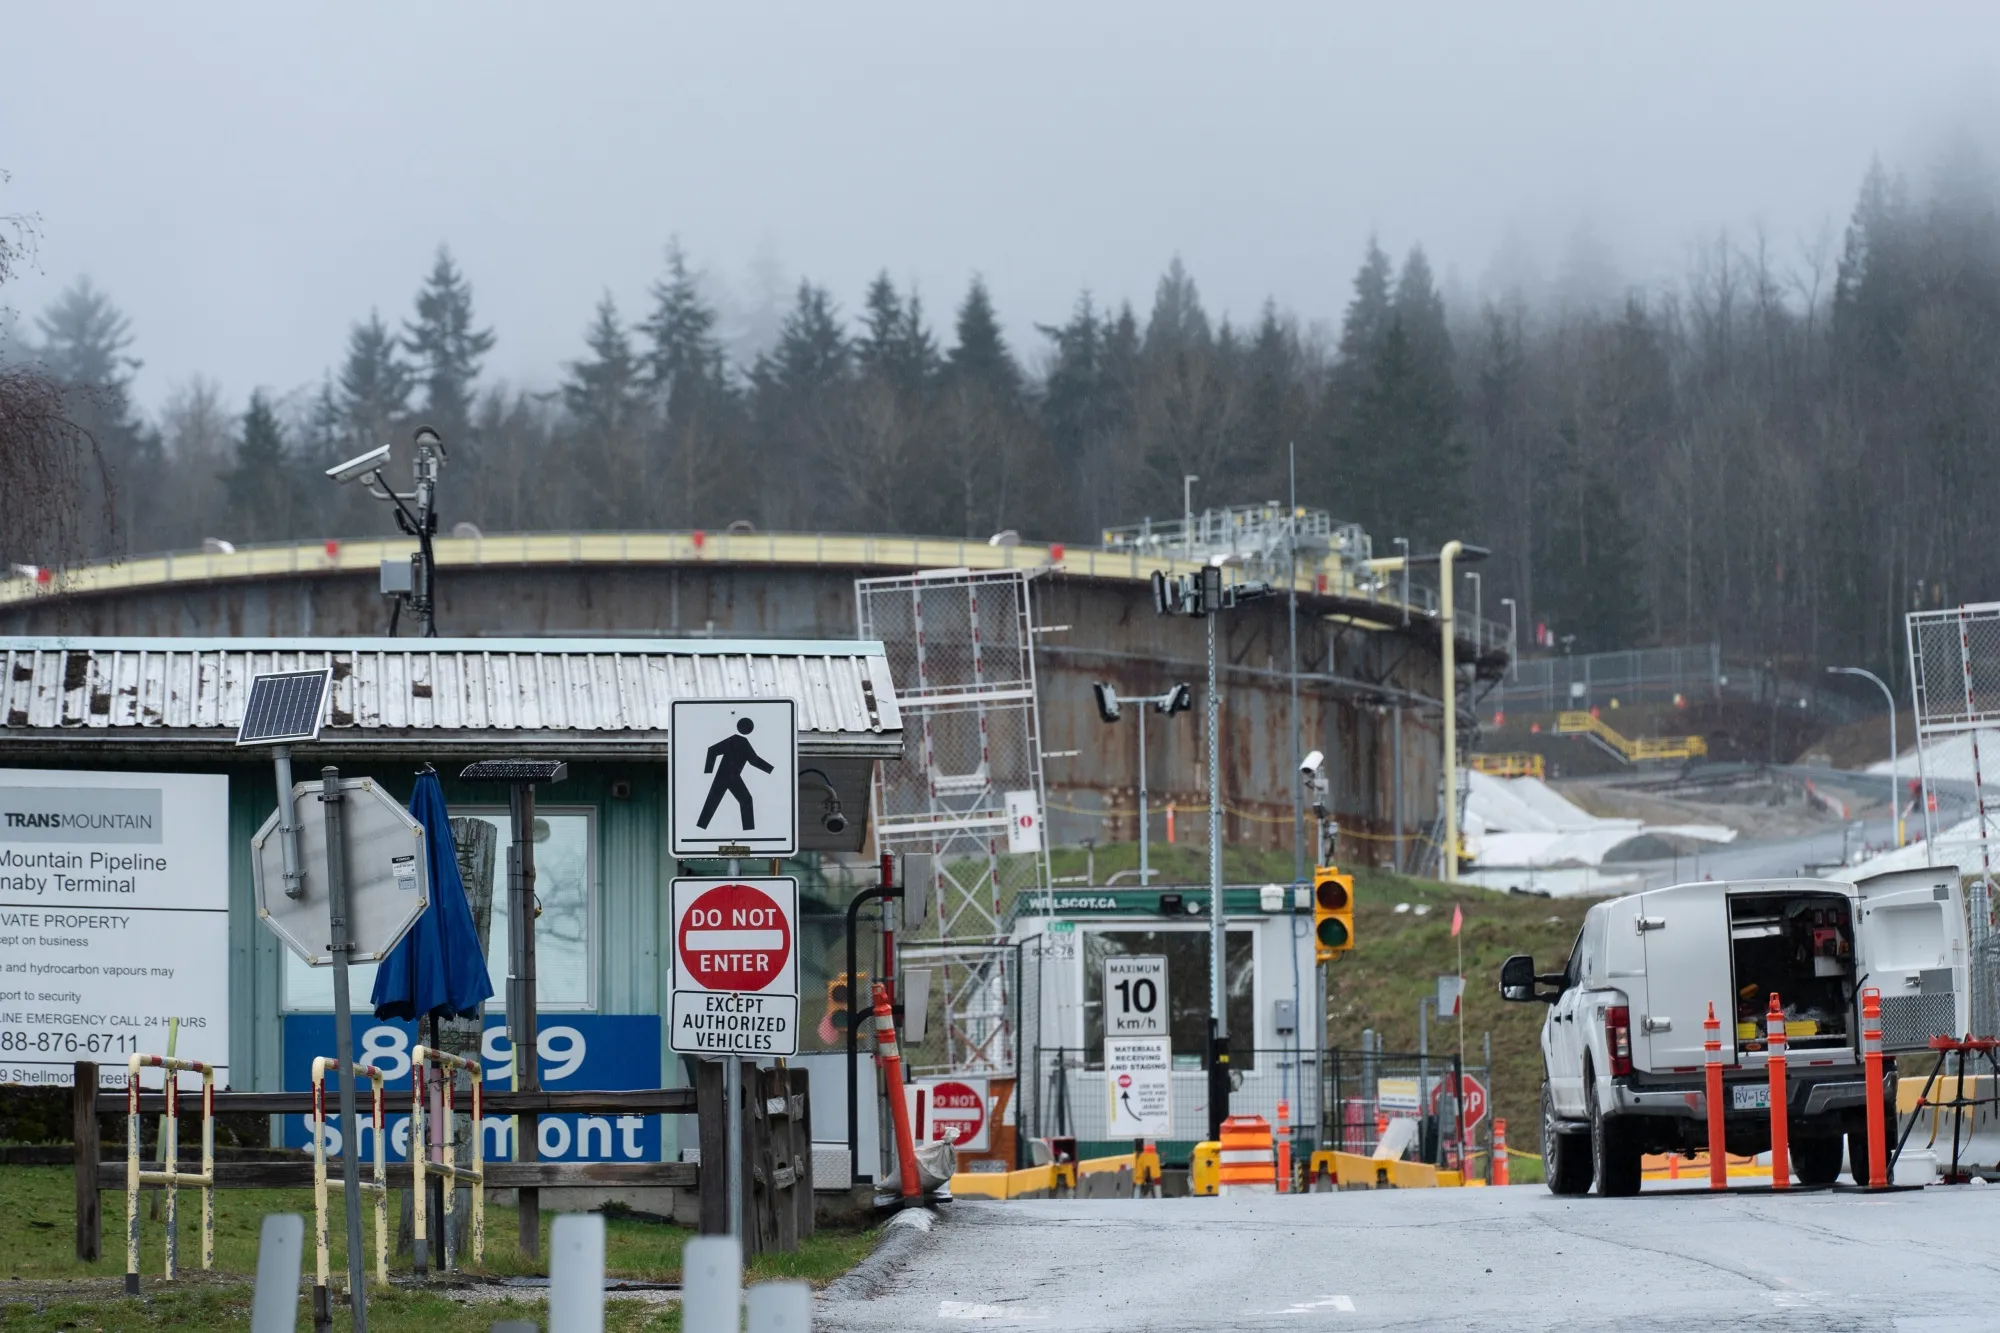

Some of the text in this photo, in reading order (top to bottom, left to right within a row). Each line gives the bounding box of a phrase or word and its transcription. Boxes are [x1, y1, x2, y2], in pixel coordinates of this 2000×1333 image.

[0, 849, 167, 873] Mountain Pipeline
[0, 873, 135, 895] naby Terminal
[0, 913, 129, 929] VATE PROPERTY
[692, 908, 777, 927] DO NOT
[0, 935, 89, 947] ept on business
[5, 963, 27, 973] and
[30, 962, 99, 976] hydrocarbon
[103, 966, 147, 978] vapours
[150, 967, 175, 979] may
[700, 954, 769, 972] ENTER
[1110, 965, 1160, 974] MAXIMUM
[24, 991, 35, 1001] to
[38, 992, 82, 1005] security
[1114, 978, 1157, 1013] 10
[706, 996, 764, 1014] EXCEPT
[0, 1012, 207, 1028] INE EMERGENCY CALL 24 HURS
[682, 1013, 787, 1032] AUTHORIZED
[1116, 1017, 1157, 1030] km/h
[1, 1031, 138, 1053] 88-876-6711
[696, 1032, 773, 1050] VEHICLES
[1114, 1045, 1162, 1053] MATERIALS
[359, 1025, 587, 1081] 899
[1115, 1055, 1161, 1063] RECEIVING
[1110, 1063, 1167, 1071] AND STAGING
[12, 1069, 75, 1084] Shellmo
[950, 1095, 976, 1107] NOT
